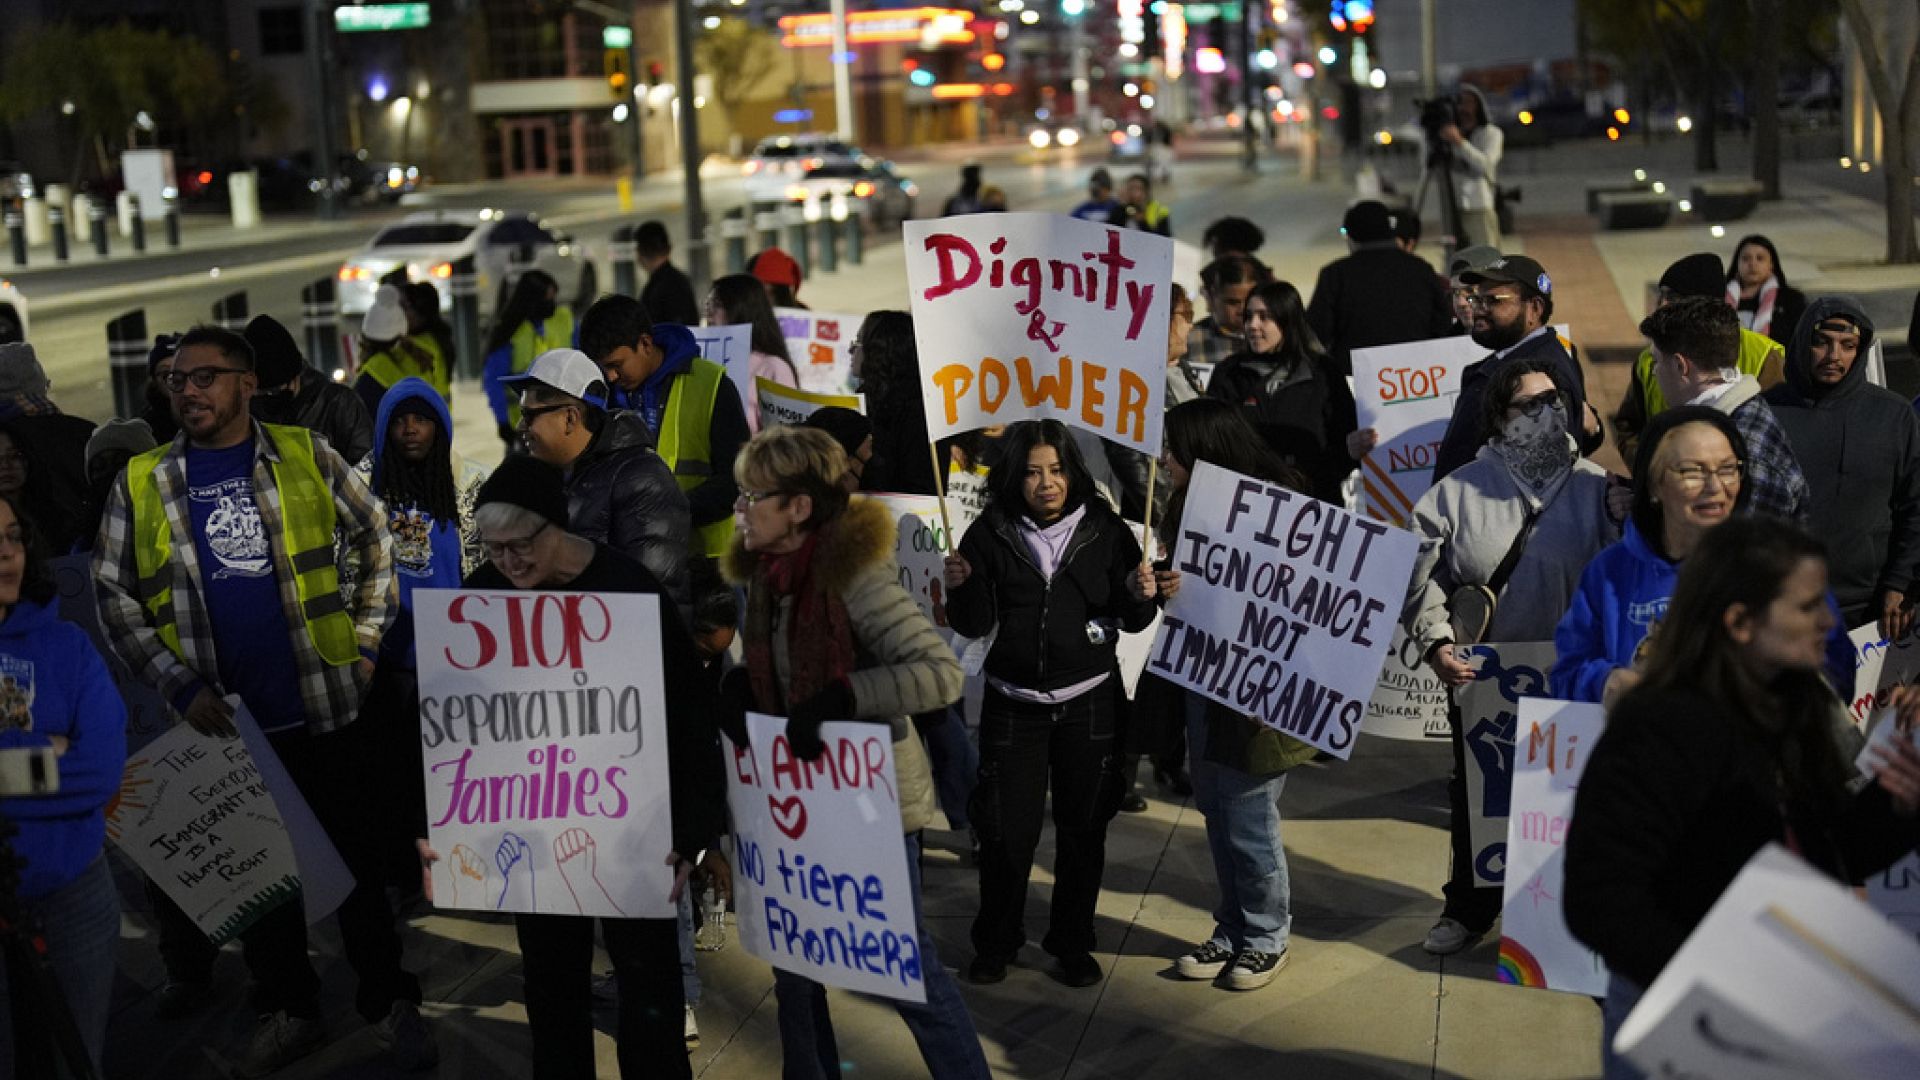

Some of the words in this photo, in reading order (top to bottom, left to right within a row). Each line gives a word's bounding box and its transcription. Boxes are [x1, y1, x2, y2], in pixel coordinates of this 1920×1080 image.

[924, 230, 1155, 340] Dignity
[1027, 309, 1067, 352] &
[932, 355, 1149, 442] POWER
[1378, 366, 1446, 400] STOP
[1226, 479, 1387, 582] FIGHT
[1181, 530, 1385, 648] IGNORANCE
[444, 594, 612, 670] STOP
[1237, 601, 1309, 661] NOT
[420, 670, 642, 758] separating
[1152, 615, 1361, 749] IMMIGRANTS
[153, 744, 207, 773] THE
[772, 735, 895, 801] AMOR
[1527, 720, 1578, 775] Mi
[150, 791, 245, 860] IMMIGRANT
[186, 843, 206, 860] IS
[208, 833, 222, 846] A
[736, 834, 764, 886] NO
[778, 848, 887, 921] tiene
